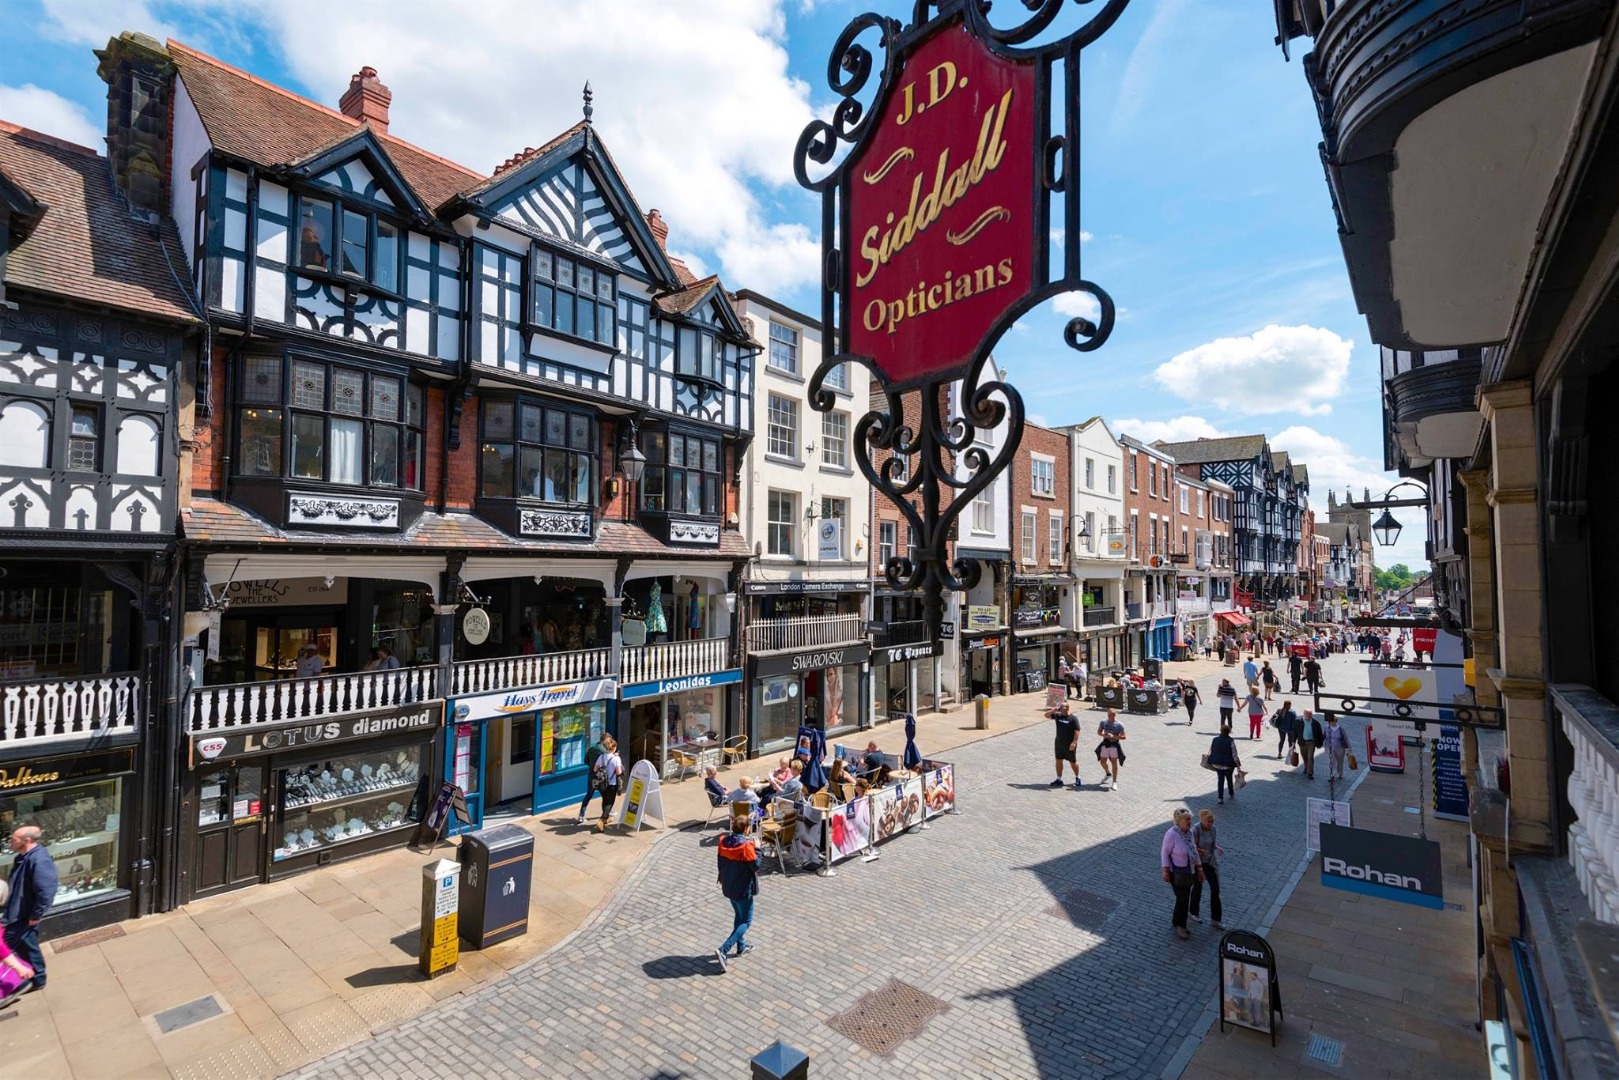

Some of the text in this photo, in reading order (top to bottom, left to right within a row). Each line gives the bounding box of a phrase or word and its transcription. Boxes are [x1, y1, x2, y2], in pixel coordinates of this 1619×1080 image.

[896, 61, 968, 125] J.D.
[856, 88, 1013, 287] Siddall
[864, 257, 1013, 333] Opticians
[248, 587, 263, 595] THE
[822, 583, 844, 591] Exchange
[231, 595, 278, 604] JEWELLERS
[792, 651, 844, 670] SWAROVSKI
[658, 676, 712, 693] Leonidas
[503, 685, 579, 707] Hays Travel
[244, 709, 430, 753] LOTUS diamond
[1439, 736, 1460, 744] NOW
[1323, 857, 1422, 891] Rohan
[1227, 942, 1264, 959] Rohan
